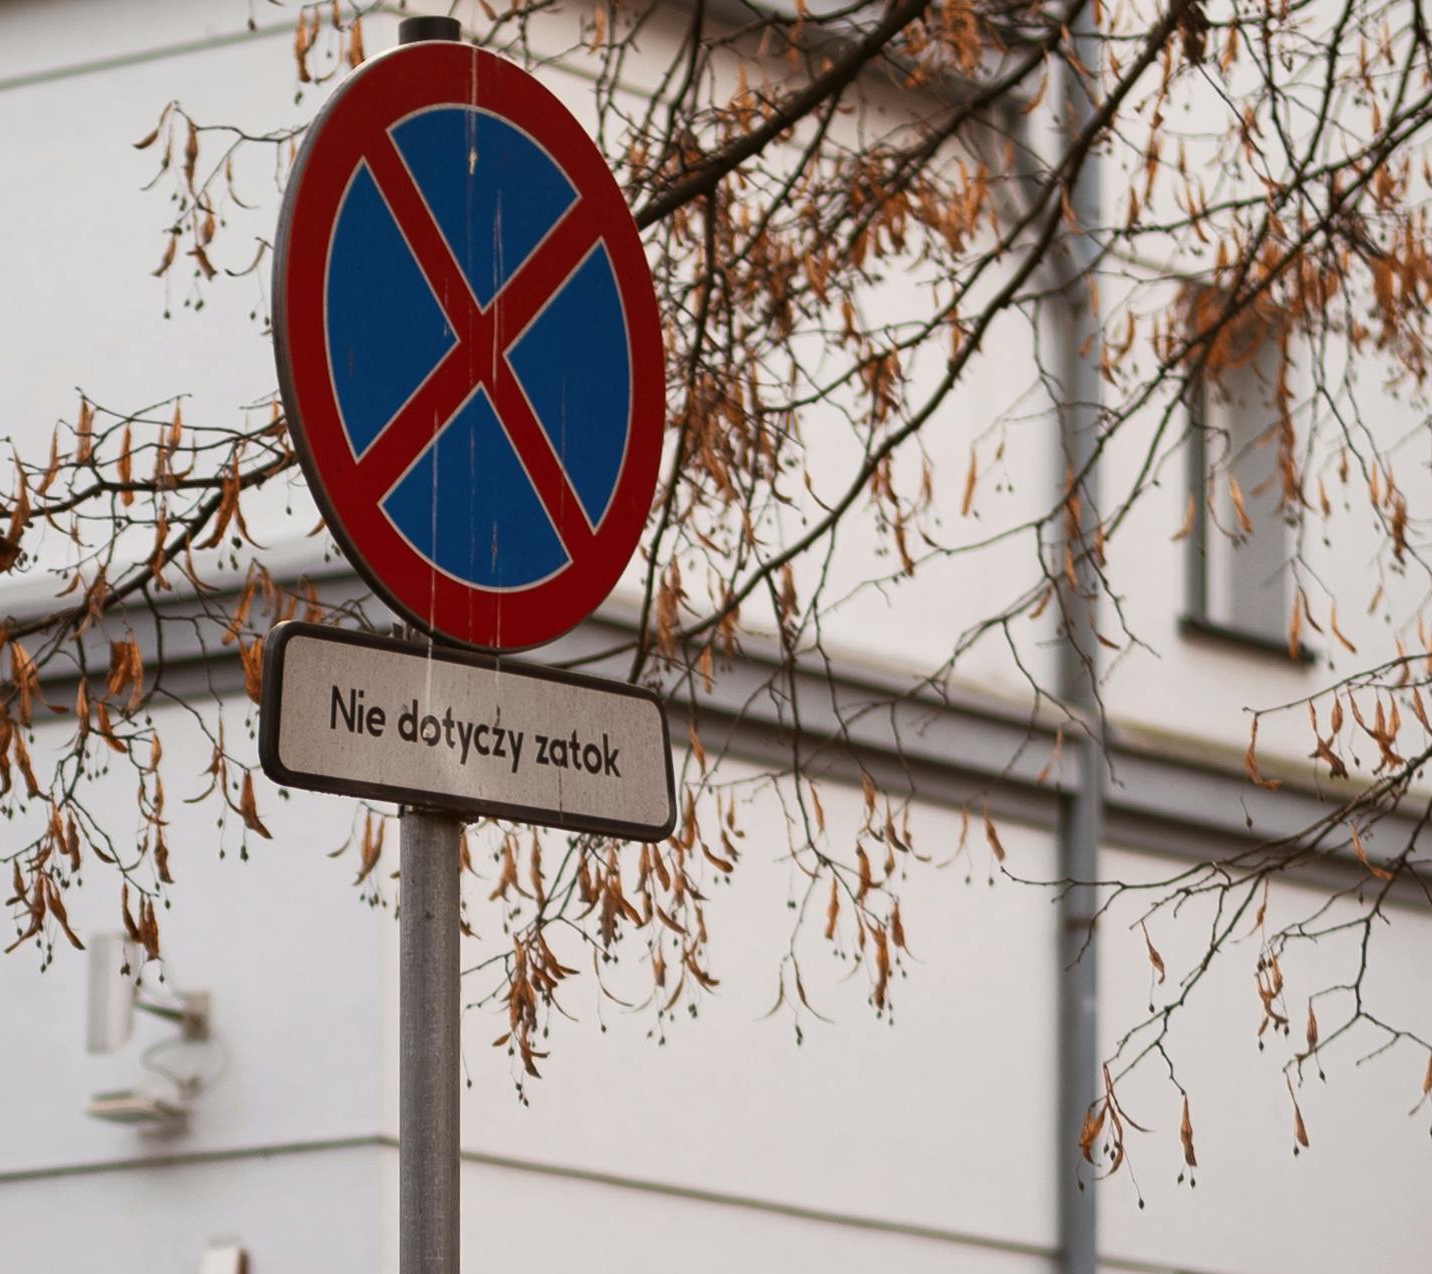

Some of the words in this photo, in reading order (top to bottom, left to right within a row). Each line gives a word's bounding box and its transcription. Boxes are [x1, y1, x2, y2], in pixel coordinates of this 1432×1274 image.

[329, 684, 386, 738] Nie
[397, 699, 524, 773] dotyczy
[535, 730, 622, 778] zatok
